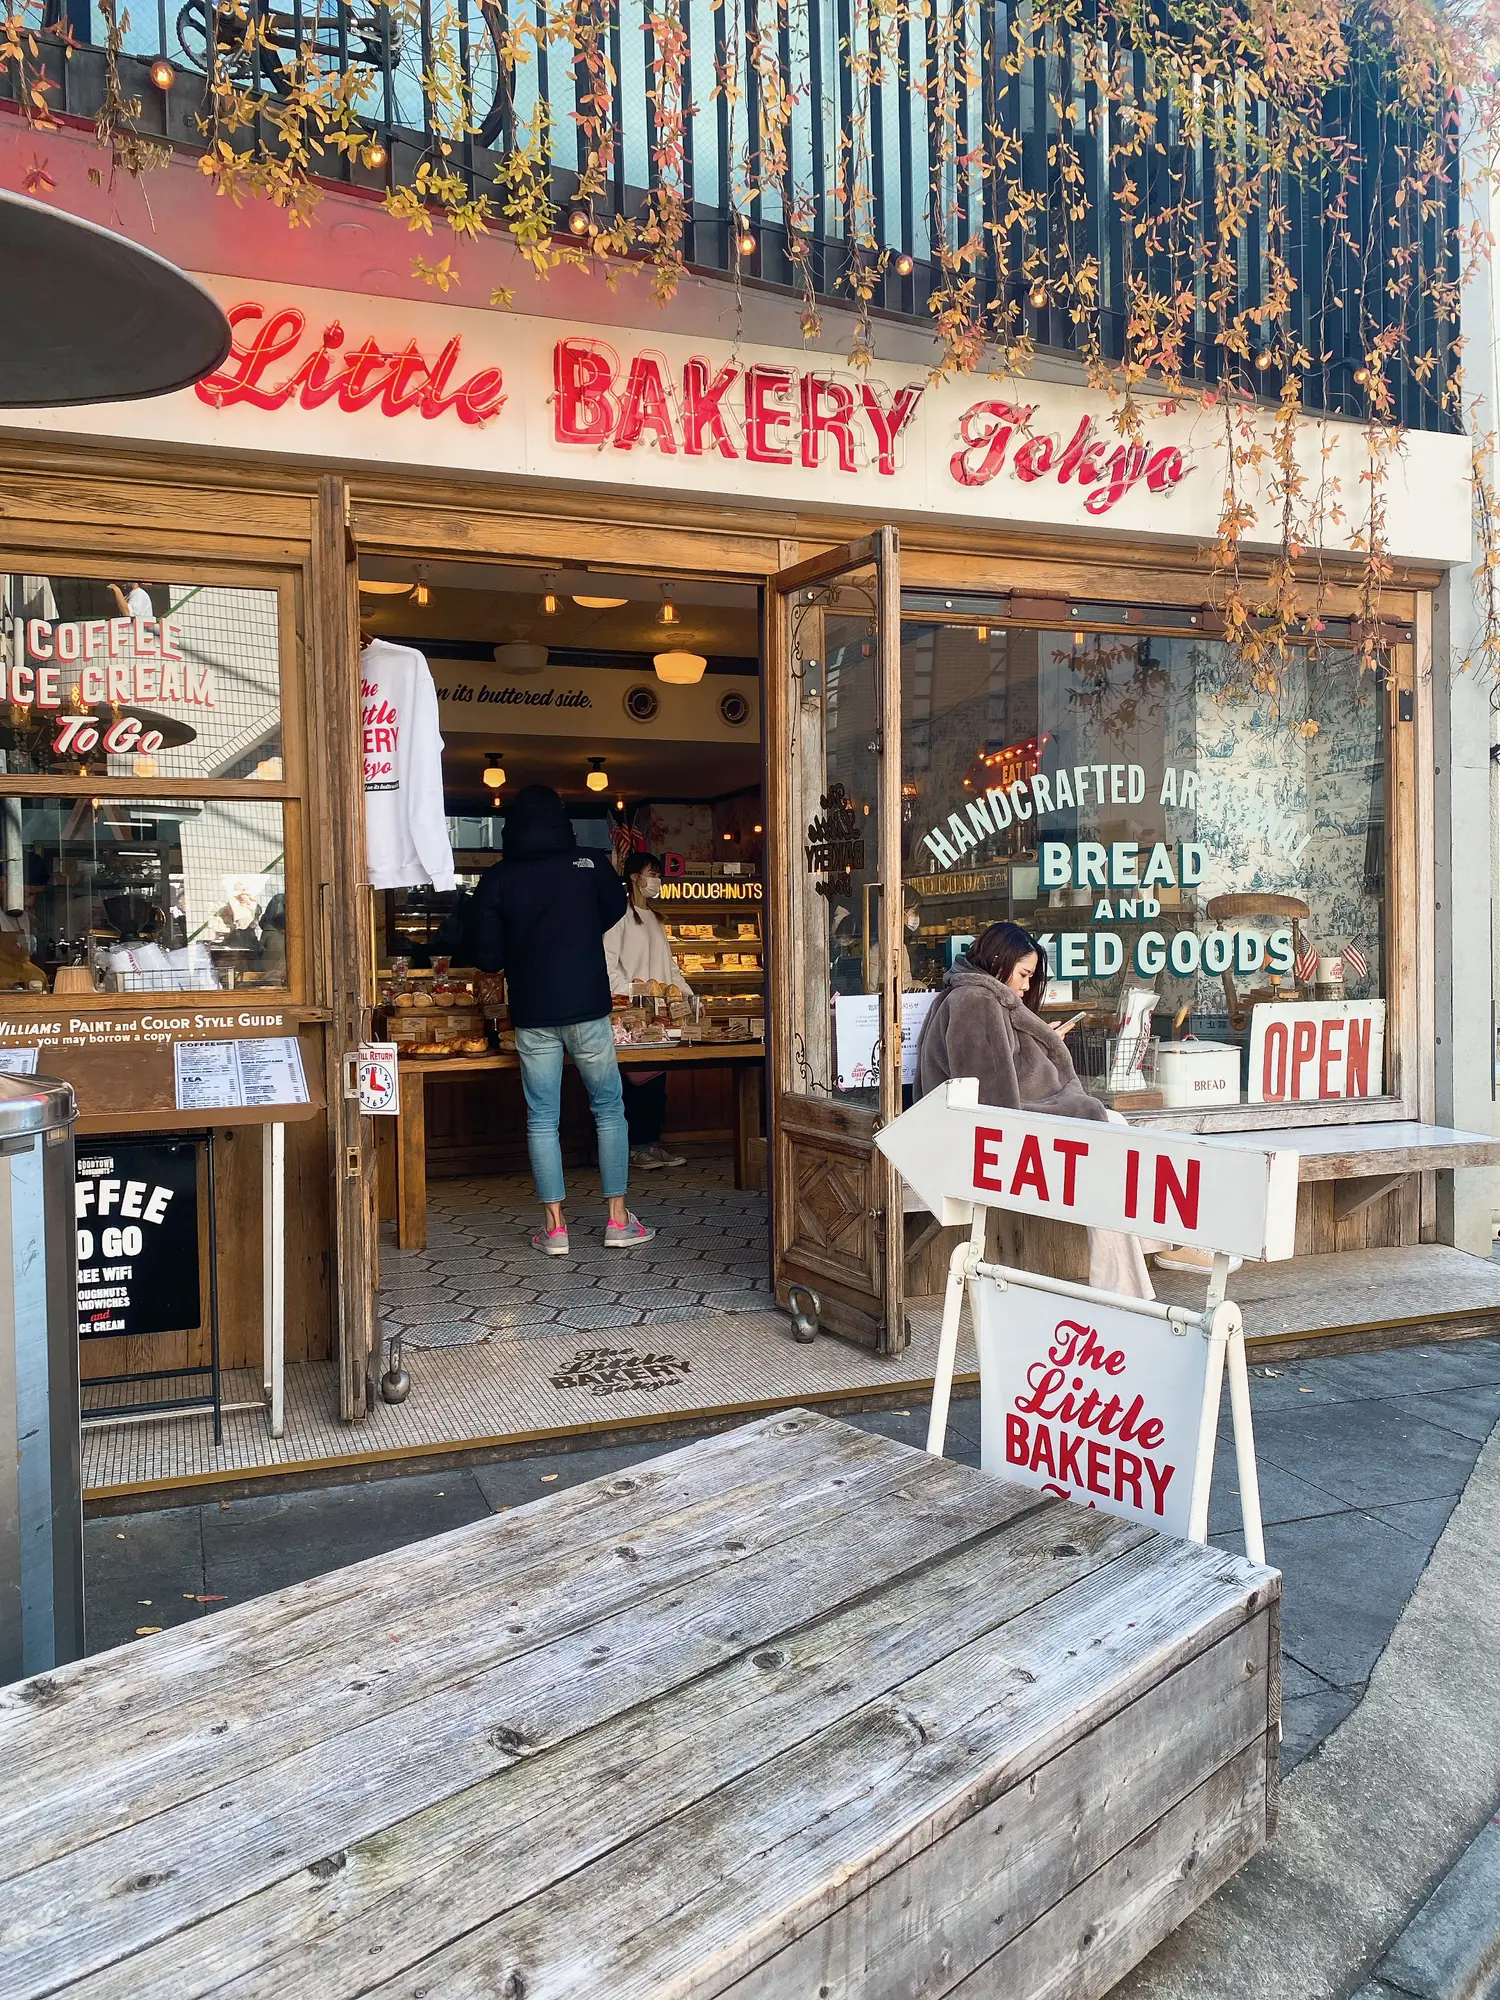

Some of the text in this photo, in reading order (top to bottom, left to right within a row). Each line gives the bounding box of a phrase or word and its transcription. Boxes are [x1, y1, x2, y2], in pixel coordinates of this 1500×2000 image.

[194, 302, 1198, 515] Little BAKERY Tokyo
[27, 615, 183, 663] COFFEE
[79, 661, 216, 707] CREAM
[361, 678, 379, 698] he
[436, 684, 593, 708] n its buttered side.
[362, 700, 397, 725] ttle
[53, 715, 164, 755] To Go
[363, 727, 399, 754] ERY
[364, 758, 392, 782] kyo
[1002, 761, 1023, 784] EAT
[923, 763, 1146, 870] HANDCRAFTED
[1039, 842, 1211, 889] BREAD
[682, 882, 763, 899] DOUGHNUTS
[1092, 899, 1161, 924] AND
[1133, 930, 1296, 979] GOODS
[69, 1019, 112, 1033] PAINT
[115, 1020, 137, 1031] and
[140, 1016, 190, 1030] COLOR
[194, 1014, 234, 1028] STYLE
[238, 1013, 283, 1026] GUIDE
[37, 1036, 58, 1047] you
[63, 1035, 86, 1046] may
[89, 1033, 130, 1043] borrow
[143, 1032, 172, 1042] copy
[360, 1052, 368, 1060] ILL
[1263, 1019, 1372, 1102] OPEN
[1194, 1080, 1226, 1091] BREAD
[972, 1126, 1201, 1230] EAT IN
[75, 1180, 175, 1225] FFEE
[77, 1225, 143, 1260] O GO
[78, 1286, 128, 1300] OUGHNUTS
[78, 1296, 131, 1310] ANDWICHES
[79, 1319, 125, 1333] CE CREAM
[90, 1309, 110, 1321] and
[574, 1347, 636, 1360] The
[1048, 1319, 1126, 1376] The
[549, 1361, 693, 1389] BAKERY
[553, 1353, 677, 1375] Little
[591, 1379, 684, 1396] Tokyo
[1014, 1361, 1166, 1450] Little
[1006, 1412, 1176, 1517] BAKERY
